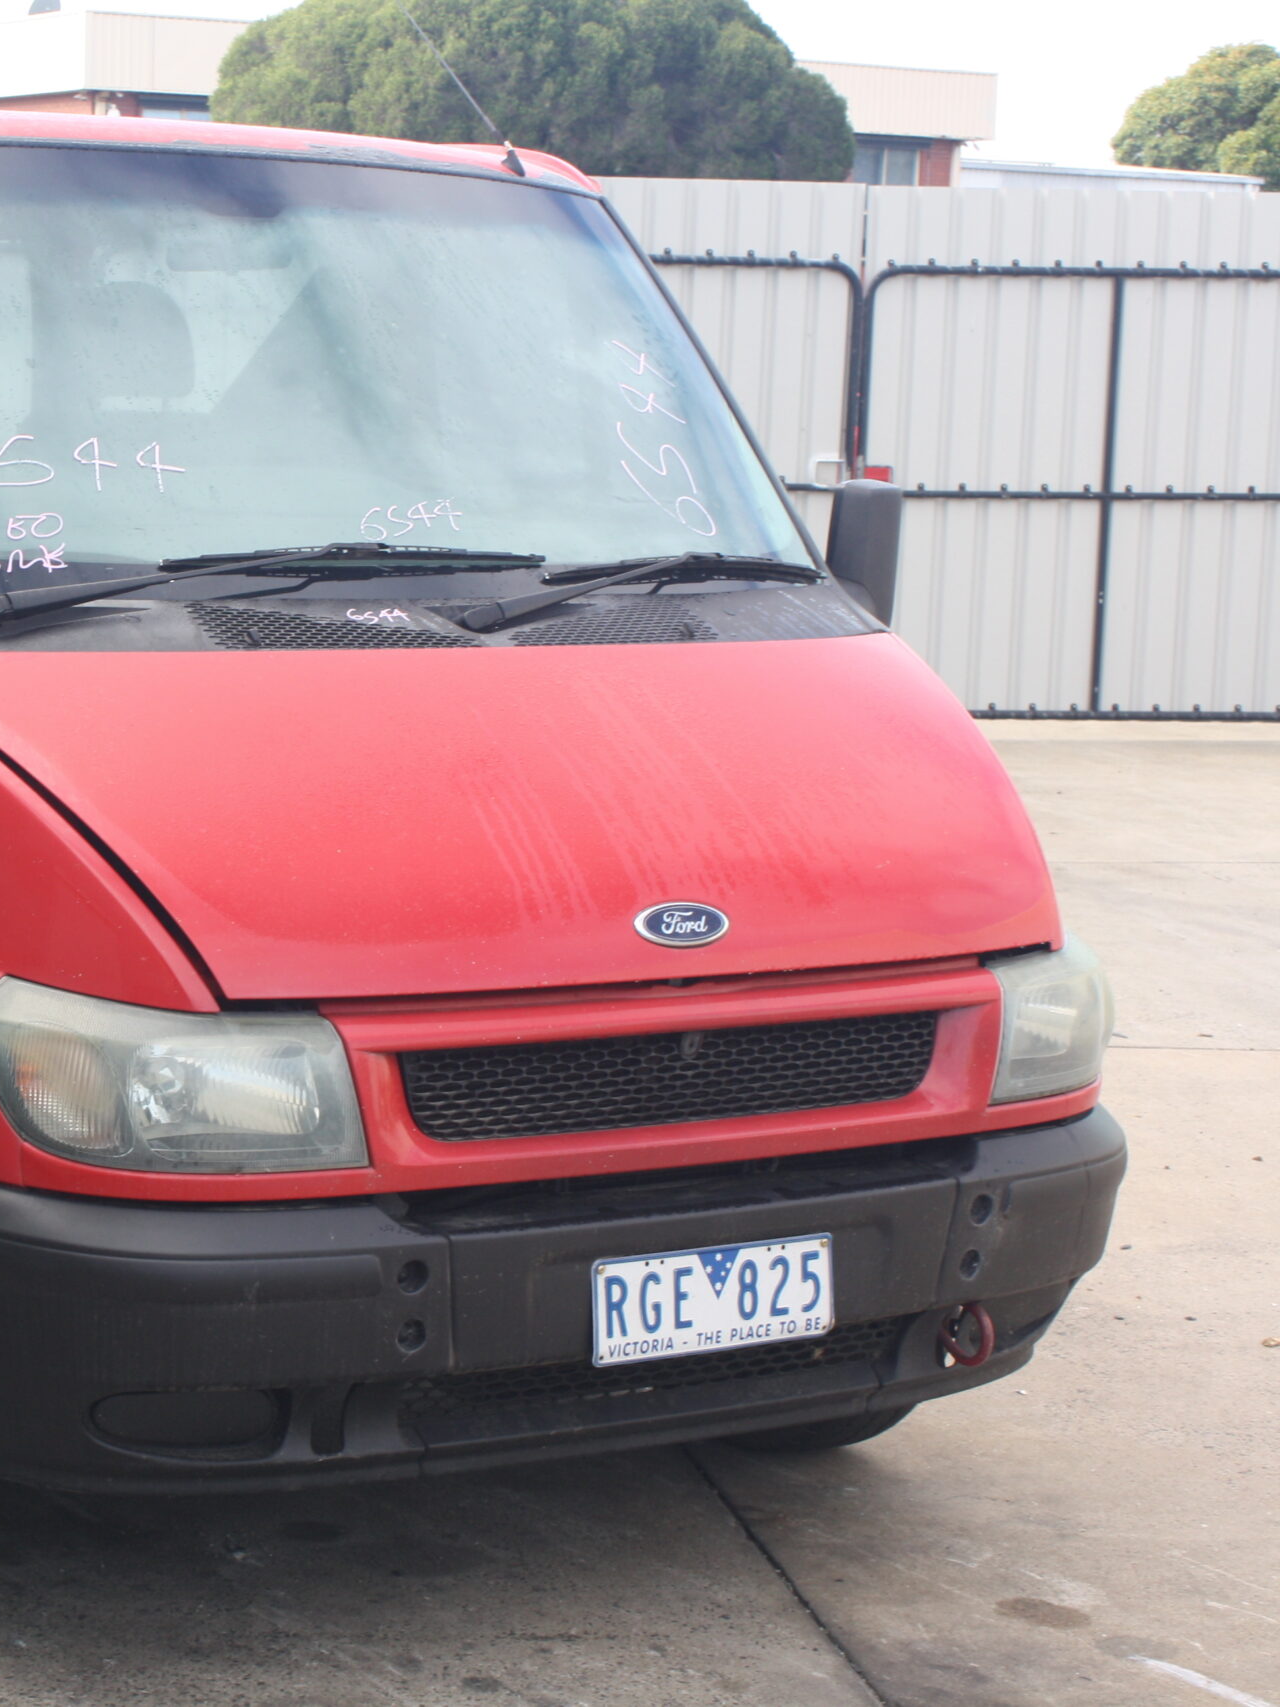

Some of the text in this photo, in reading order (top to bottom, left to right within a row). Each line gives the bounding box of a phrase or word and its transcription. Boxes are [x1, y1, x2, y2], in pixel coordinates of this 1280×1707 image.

[661, 911, 708, 935] Ford
[604, 1250, 821, 1339] RGE 825
[608, 1336, 674, 1358] VICTORIA
[696, 1330, 722, 1347] THE
[730, 1323, 772, 1342] PLACE
[779, 1320, 796, 1335] TO
[804, 1317, 821, 1331] BE
